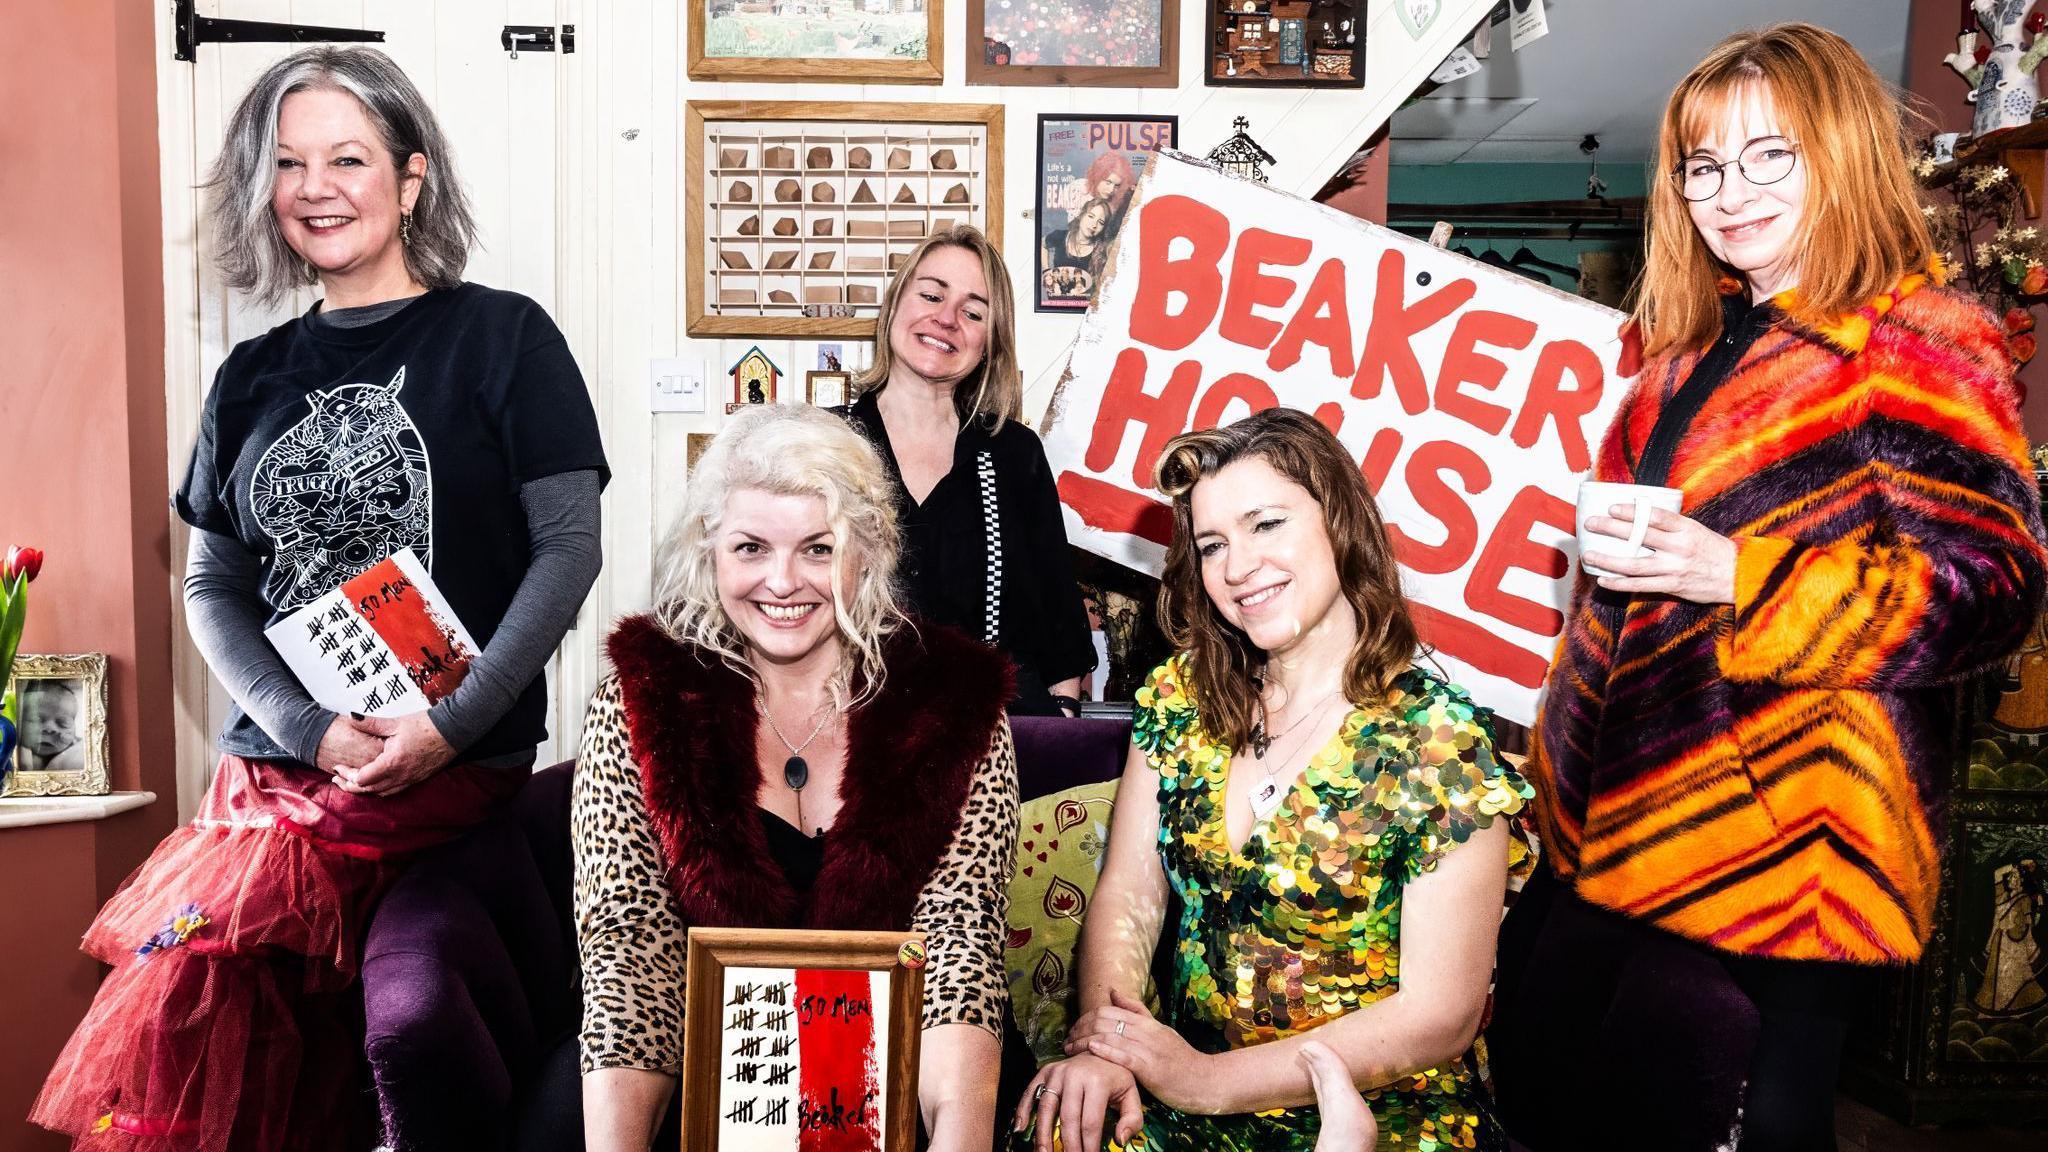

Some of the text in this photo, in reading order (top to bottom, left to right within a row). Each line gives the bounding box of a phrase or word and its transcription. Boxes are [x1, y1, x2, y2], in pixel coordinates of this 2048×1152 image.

[1090, 123, 1170, 151] PULSE
[272, 475, 334, 496] TRUCK
[800, 994, 826, 1025] 50
